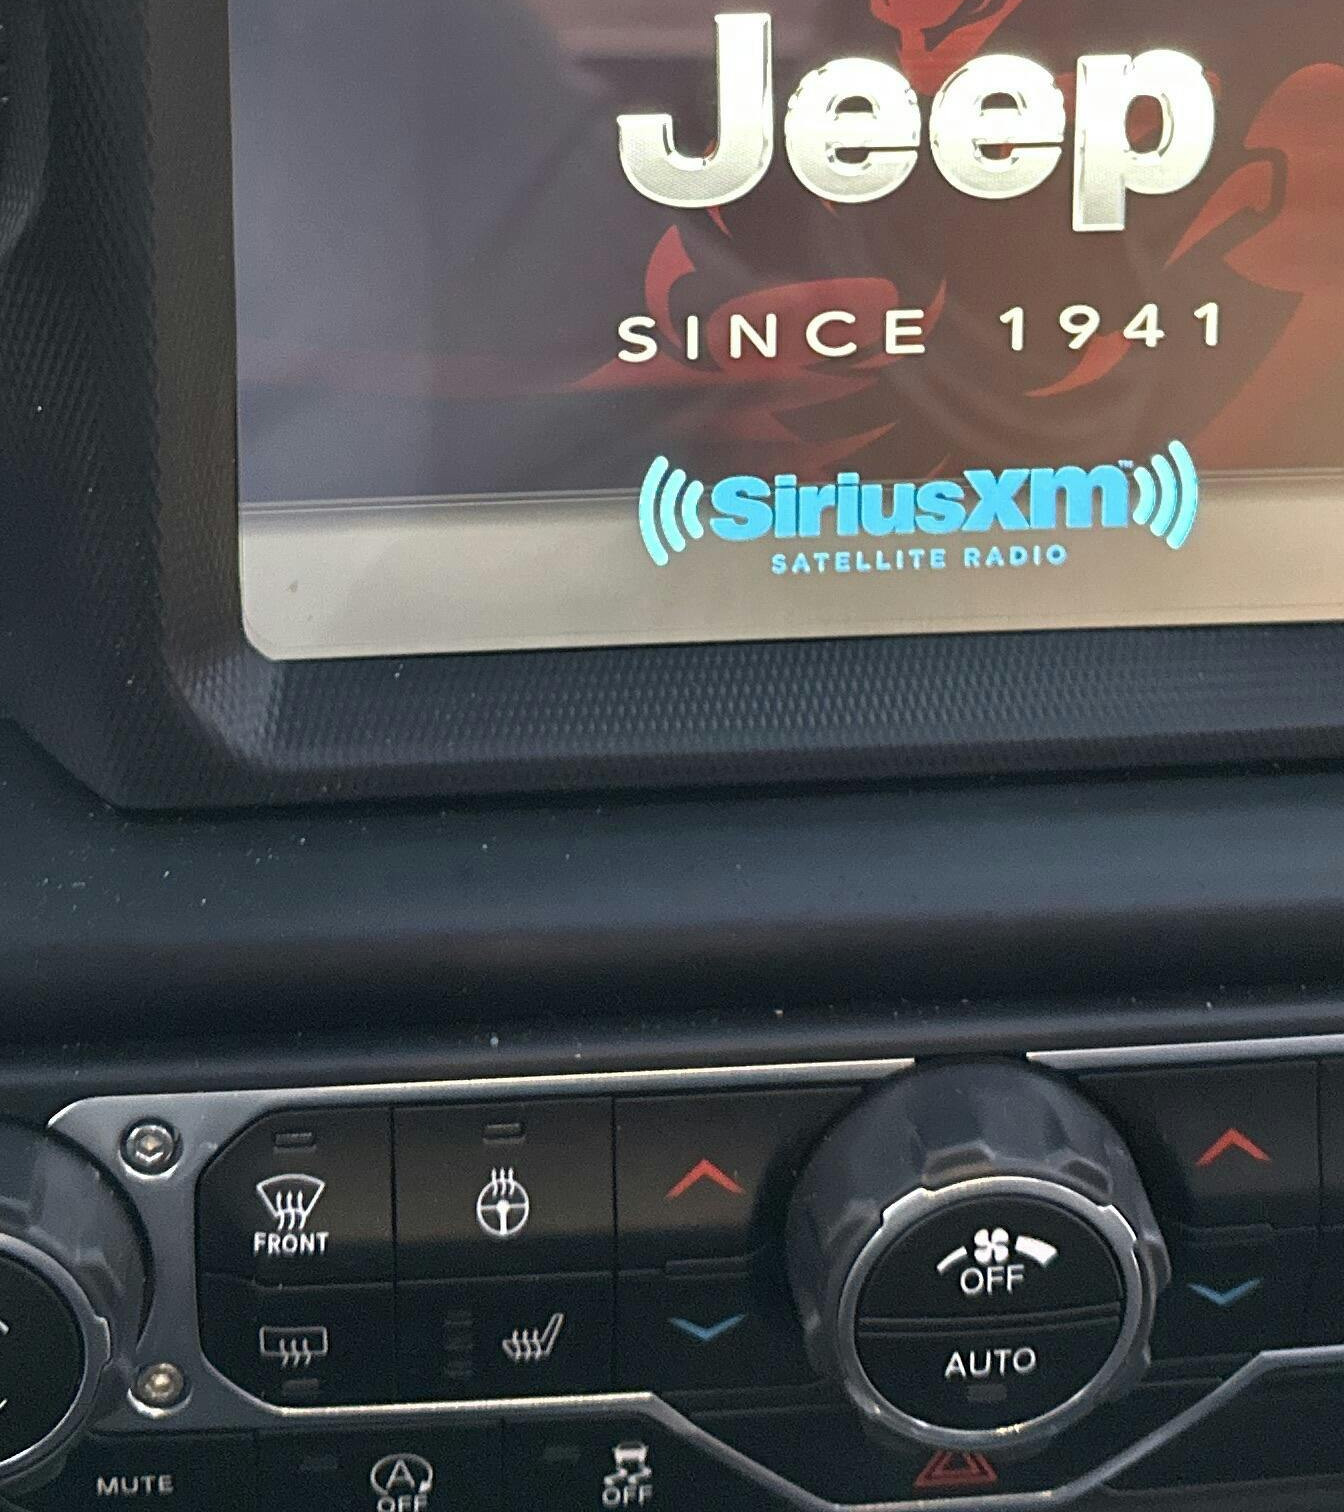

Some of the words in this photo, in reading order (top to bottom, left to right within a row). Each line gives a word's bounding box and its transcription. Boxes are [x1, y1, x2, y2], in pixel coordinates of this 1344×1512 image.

[616, 11, 1215, 232] Jeep
[617, 308, 926, 363] SINCE
[999, 301, 1220, 351] 1941
[771, 546, 946, 575] SATELLITE
[963, 542, 1068, 567] RADIO
[253, 1231, 330, 1255] FRONT
[959, 1264, 1025, 1297] OFF
[944, 1347, 1037, 1380] AUTO
[96, 1474, 175, 1497] MUTE
[602, 1484, 653, 1508] OFF
[376, 1494, 428, 1512] OFF
